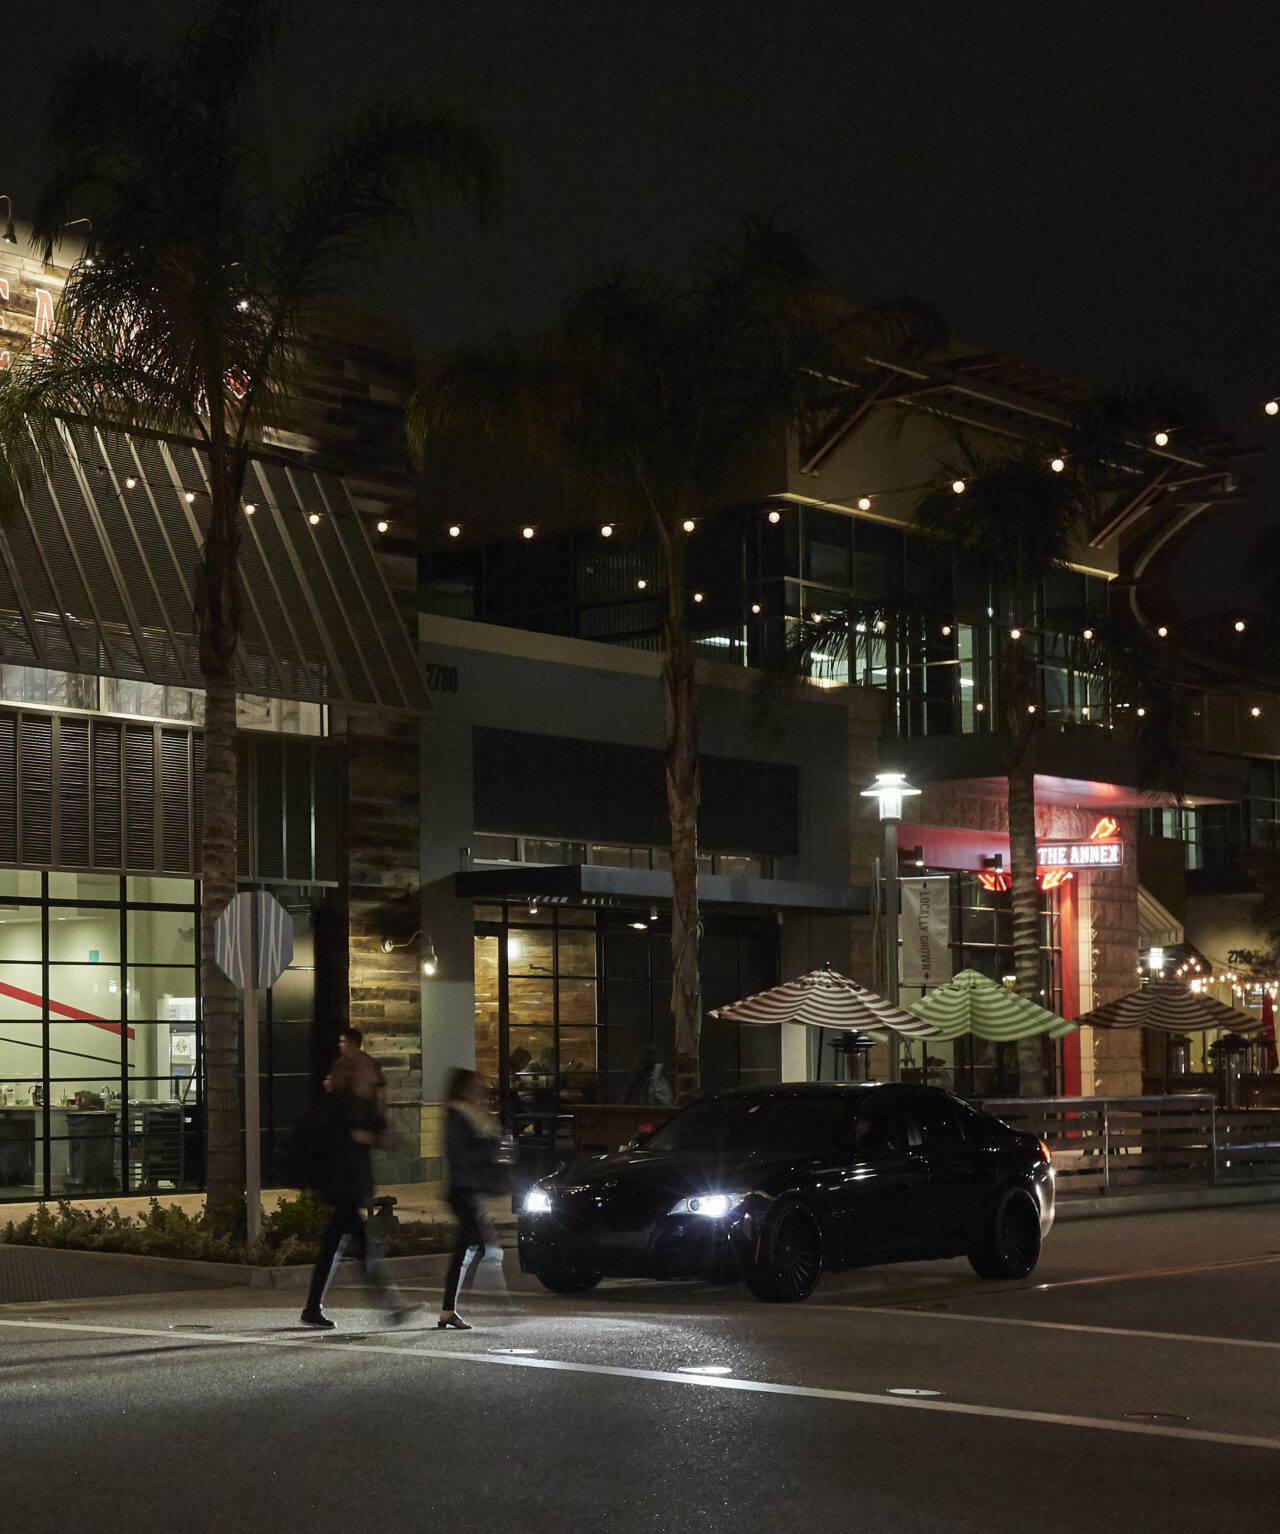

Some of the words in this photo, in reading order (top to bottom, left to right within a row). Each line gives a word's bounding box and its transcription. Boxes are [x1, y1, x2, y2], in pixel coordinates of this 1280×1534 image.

[1037, 847, 1067, 865] THE
[1069, 845, 1119, 864] ANNEX
[919, 891, 930, 932] LOCALLY
[920, 935, 931, 970] GROWN
